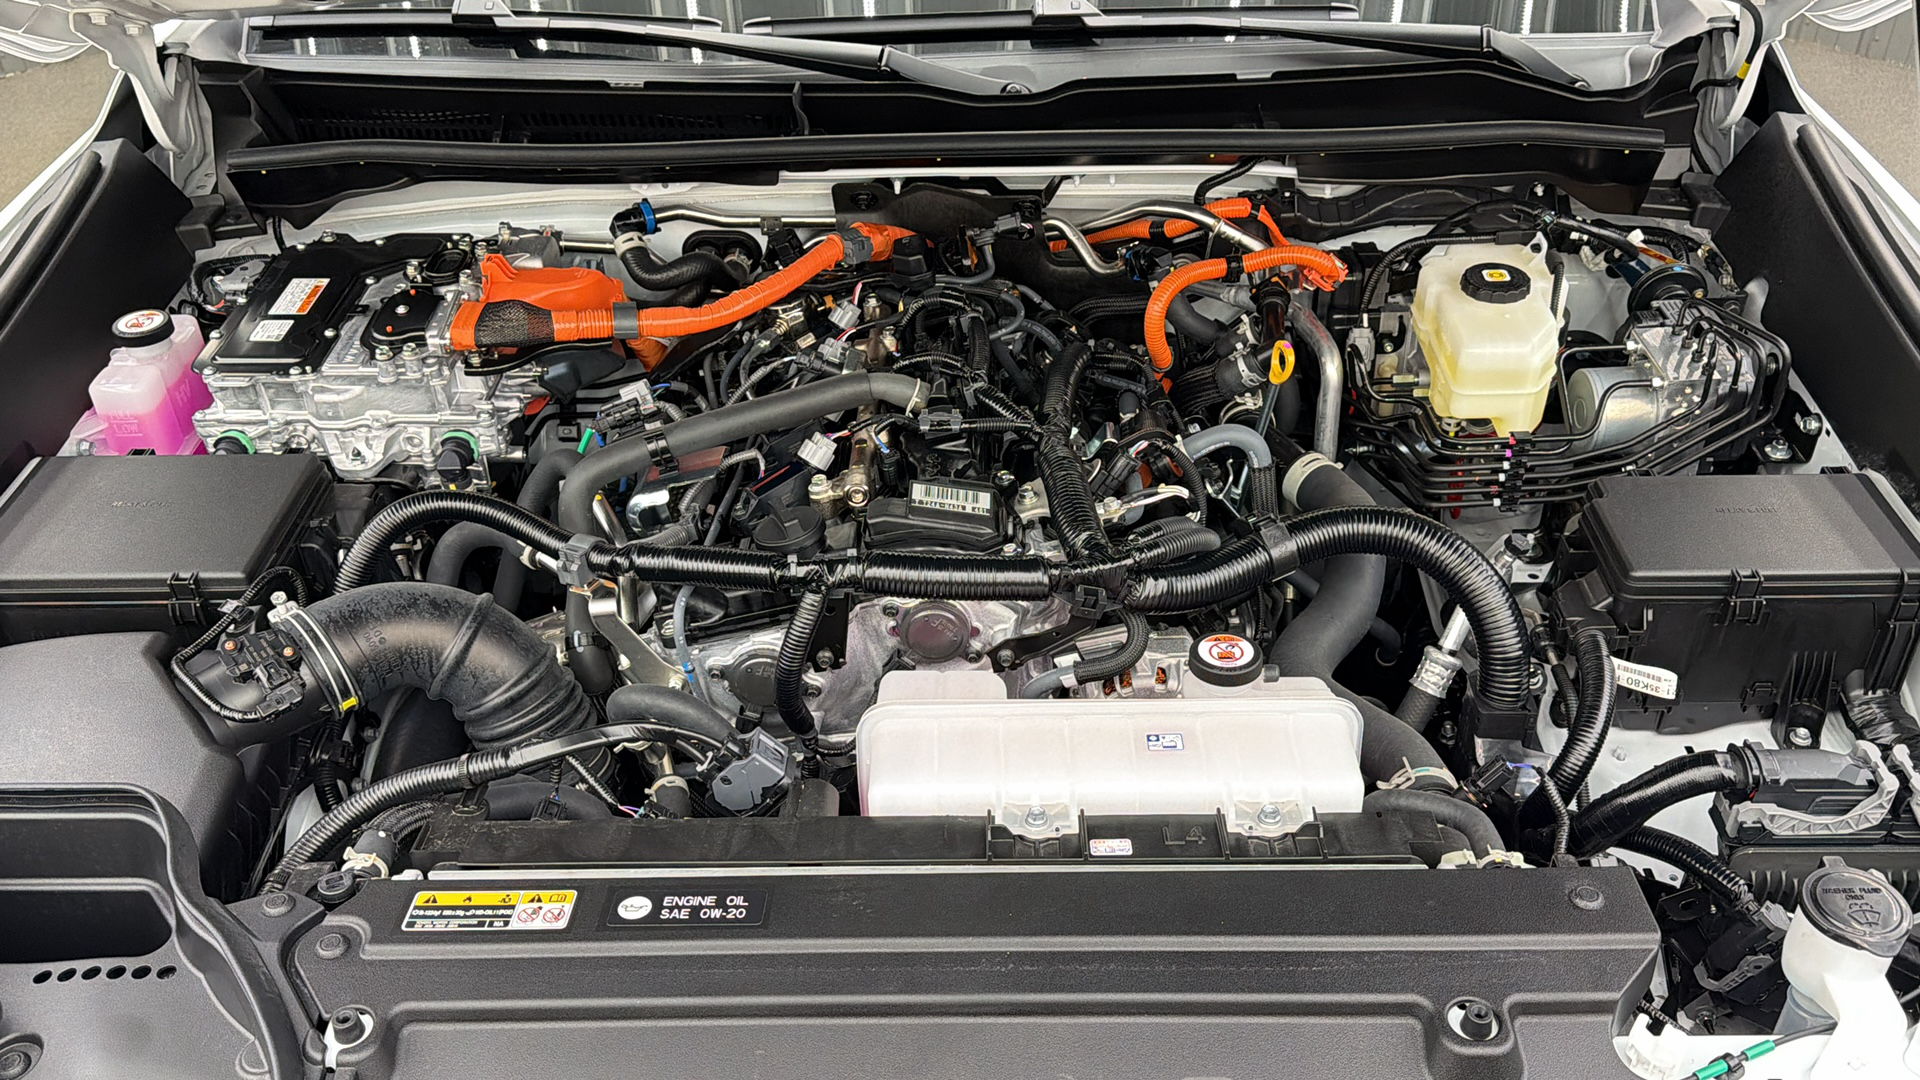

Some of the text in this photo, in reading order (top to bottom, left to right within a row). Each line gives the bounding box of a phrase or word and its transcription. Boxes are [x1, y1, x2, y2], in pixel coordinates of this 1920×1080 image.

[113, 423, 139, 434] LOW
[662, 895, 749, 907] ENGINE OIL
[659, 908, 746, 919] SAE 0W-20
